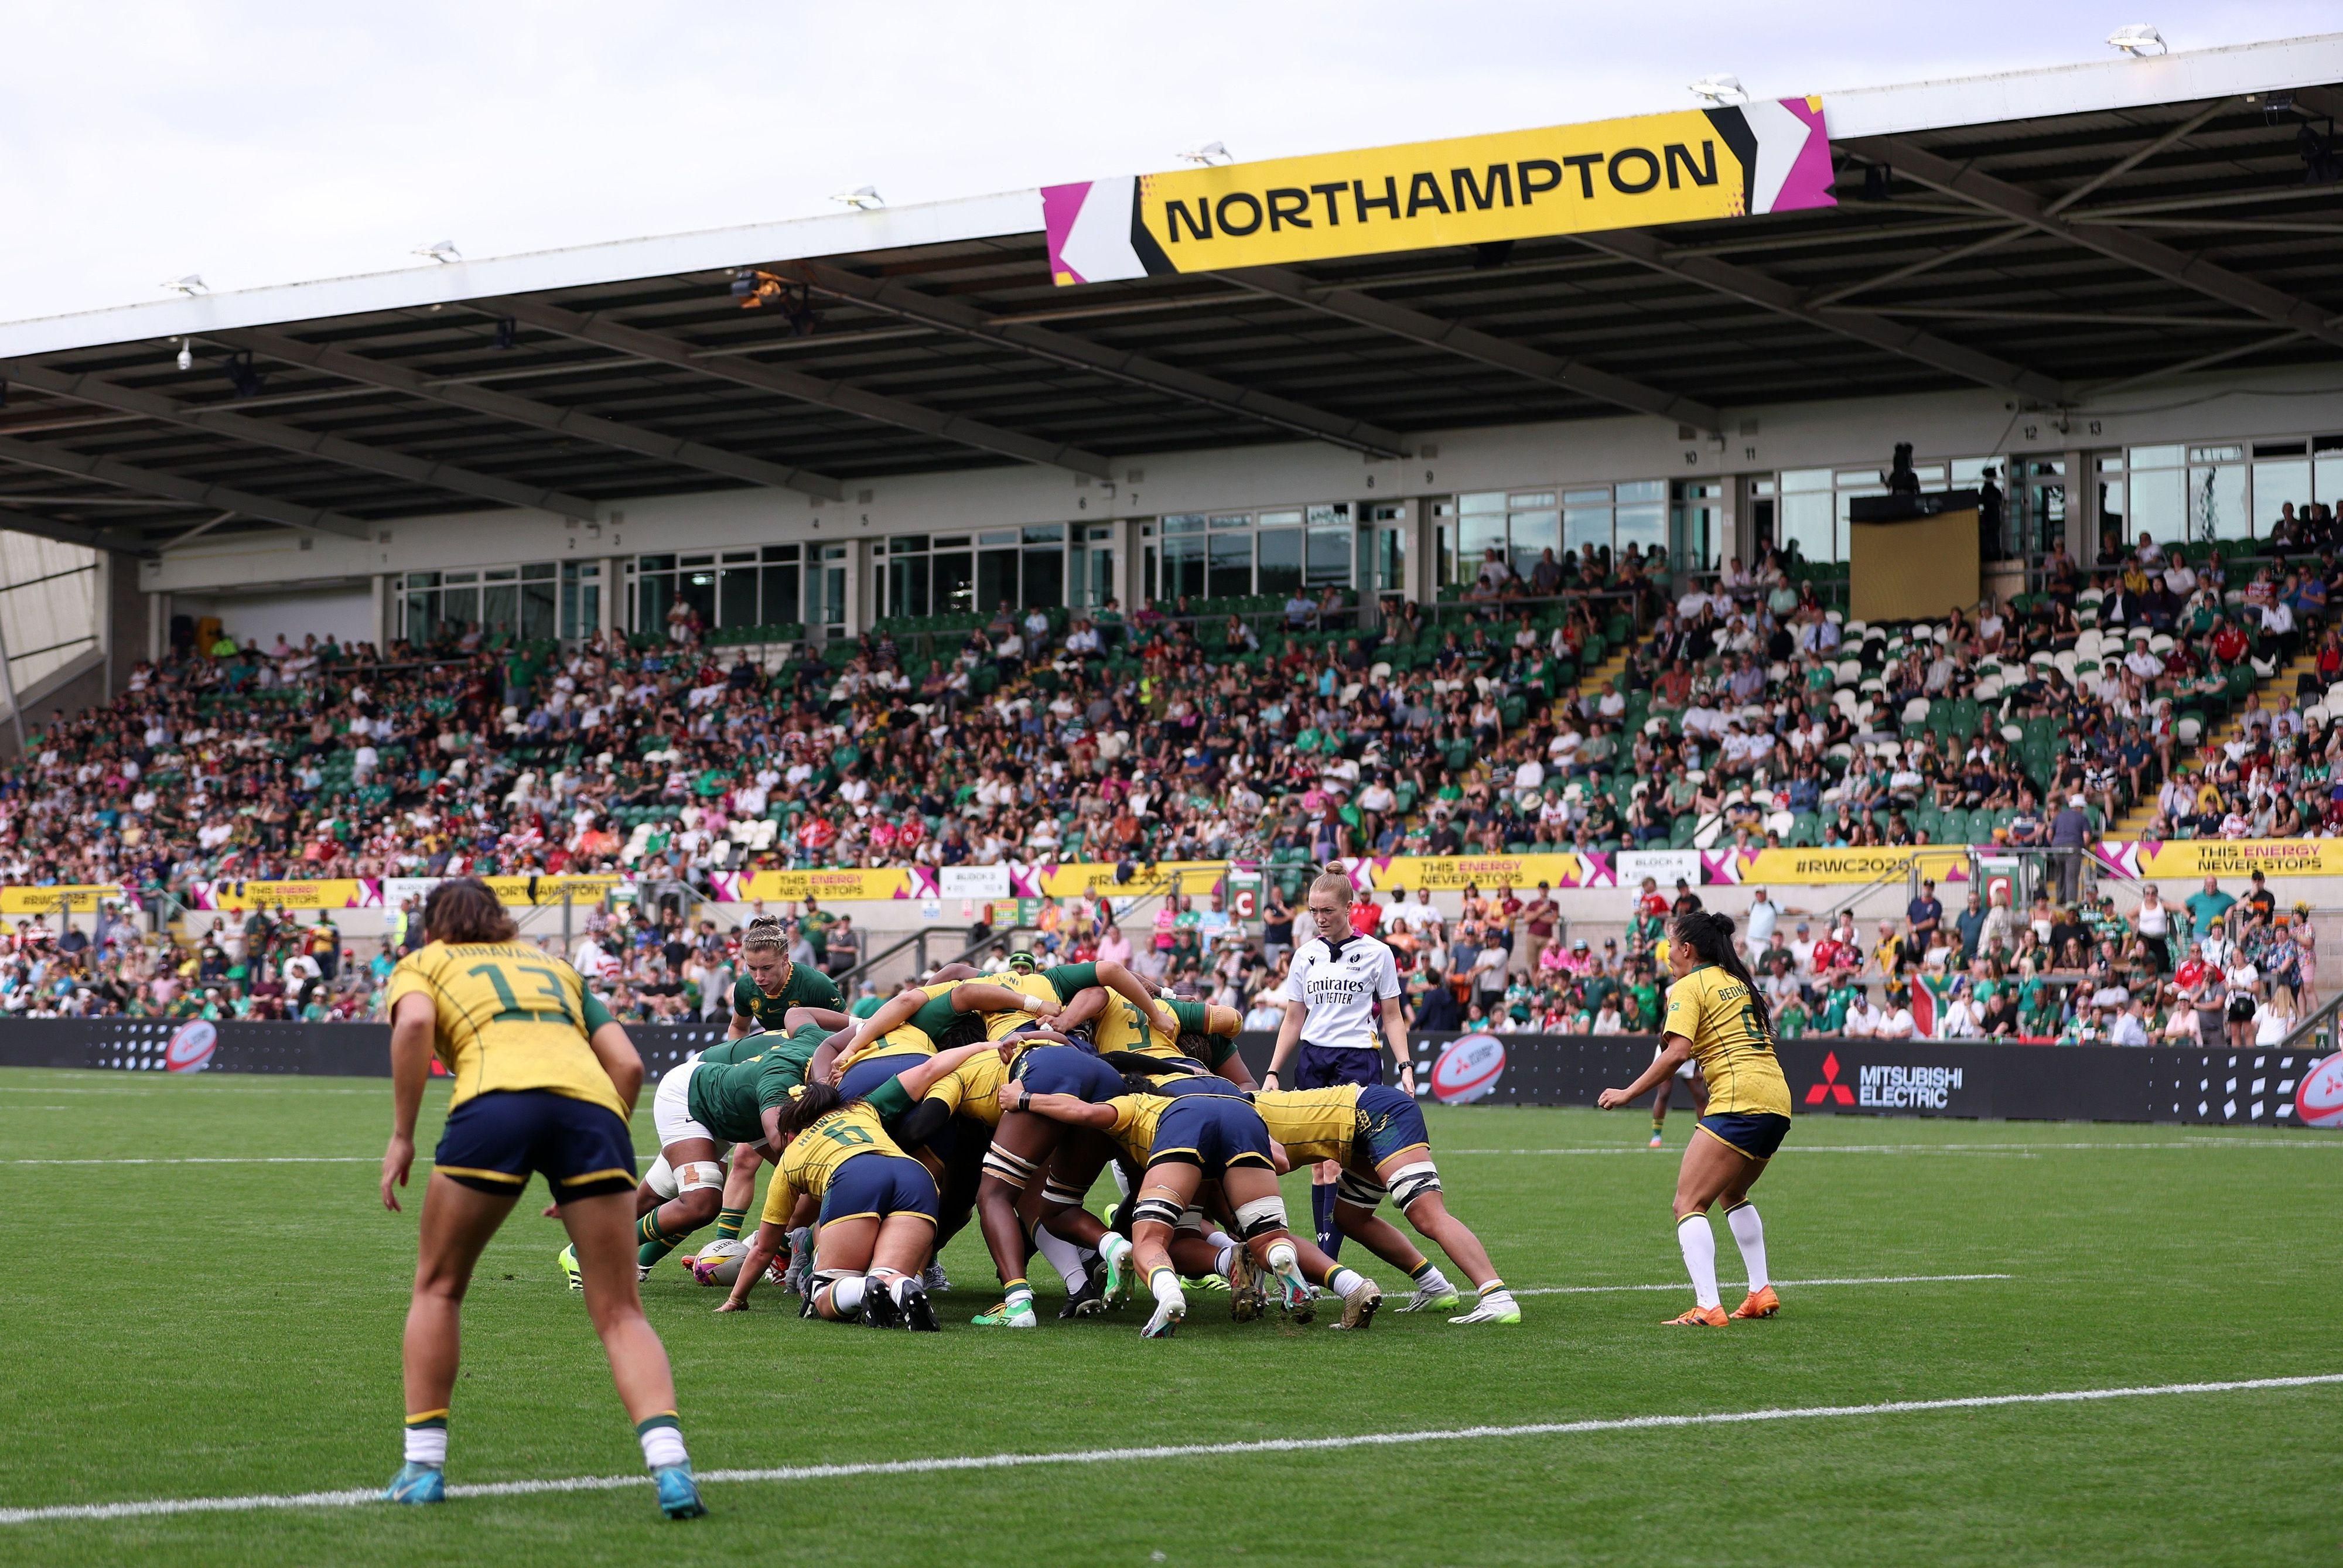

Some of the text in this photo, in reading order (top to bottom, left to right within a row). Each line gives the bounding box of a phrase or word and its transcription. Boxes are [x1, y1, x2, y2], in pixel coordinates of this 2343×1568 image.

[1166, 140, 1719, 242] NORTHAMPTON
[2024, 425, 2037, 440] 12
[2089, 421, 2102, 436] 13
[1685, 450, 1698, 466] 10
[1746, 446, 1756, 461] 11
[1367, 475, 1375, 490] 8
[1426, 470, 1434, 484] 9
[1131, 493, 1139, 506] 7
[568, 537, 576, 549] 2
[2198, 844, 2321, 858] THIS ENERGY
[1421, 860, 1522, 872] THIS ENERGY
[1635, 858, 1672, 866] BLOCK
[2198, 858, 2322, 871] NEVER STOPS
[780, 874, 863, 884] THIS ENERGY
[1420, 872, 1524, 884] NEVER STOPS
[779, 885, 864, 895] NEVER STOPS
[1235, 891, 1253, 917] C
[1307, 976, 1364, 995] Emirates
[467, 962, 576, 1026] 13
[1315, 992, 1324, 1005] LY
[1717, 985, 1750, 1002] BEDNA
[1860, 1065, 1963, 1089] MITSUBISHI
[1859, 1085, 1949, 1109] ELECTRIC
[822, 1119, 875, 1146] 6
